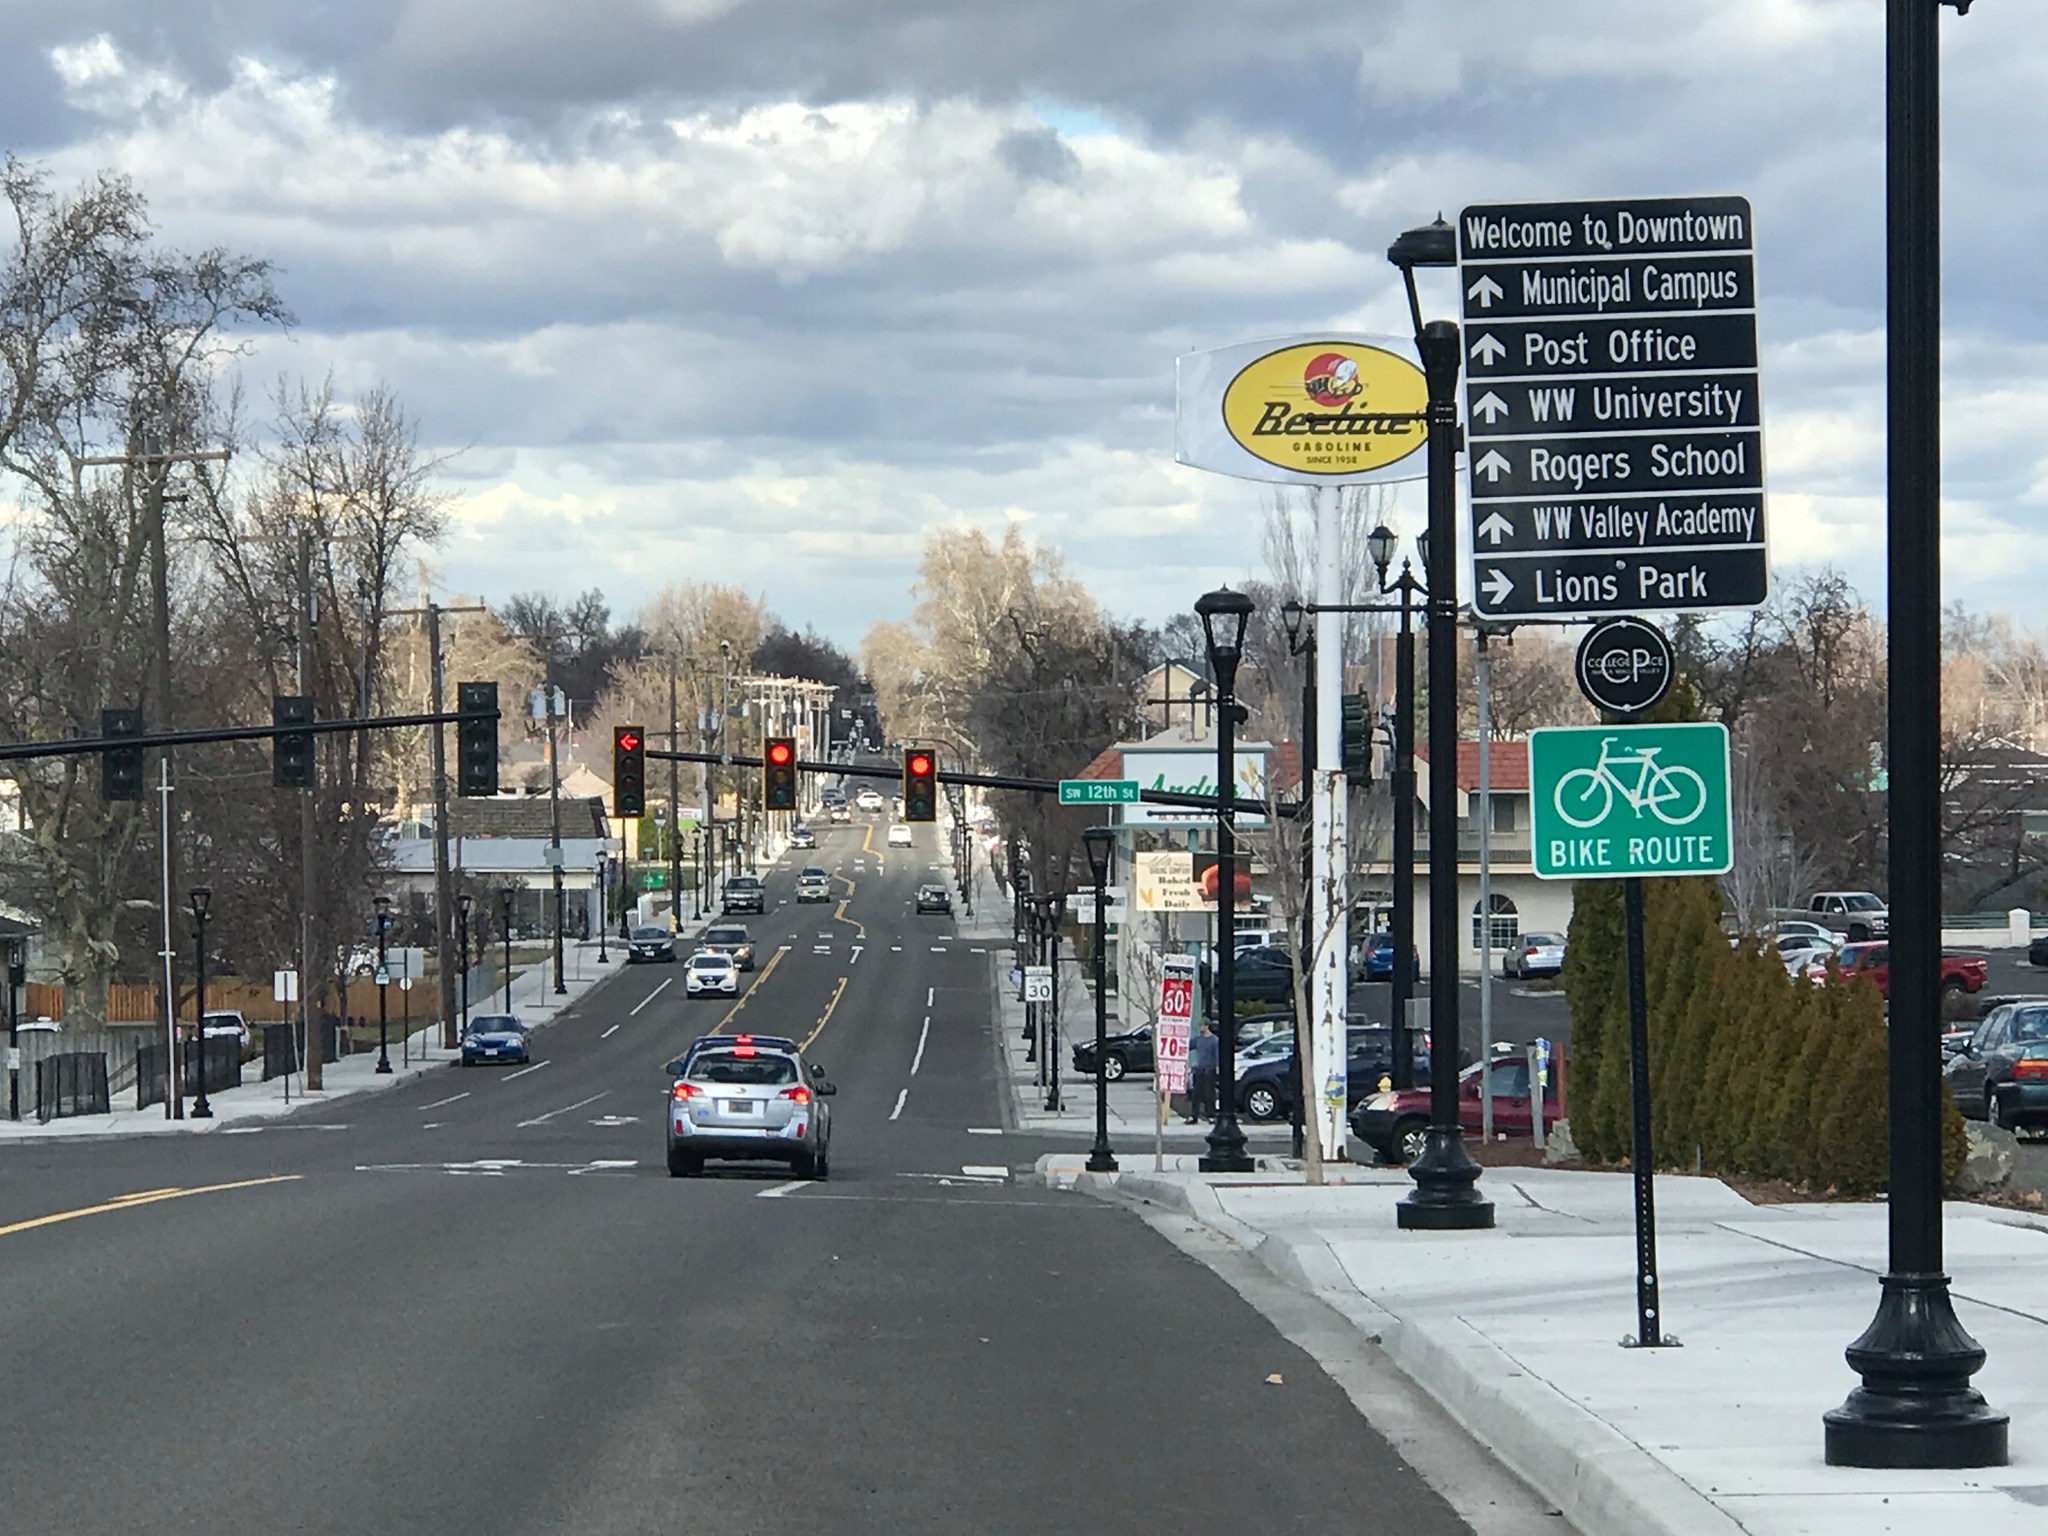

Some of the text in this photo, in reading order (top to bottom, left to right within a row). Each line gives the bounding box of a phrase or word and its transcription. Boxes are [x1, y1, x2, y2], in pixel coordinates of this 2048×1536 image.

[1467, 210, 1744, 249] Welcome to Downtown
[1522, 265, 1738, 311] Municipal Campus
[1525, 329, 1697, 366] Post Office
[1528, 382, 1742, 424] WW University
[1292, 442, 1372, 452] GASOLINE
[1306, 455, 1333, 464] SINCE
[1530, 441, 1745, 491] Rogers School
[1532, 501, 1756, 546] WW Valley Academy
[1535, 565, 1708, 603] Lions Park
[1587, 656, 1631, 668] COLEGE
[1065, 785, 1134, 799] SW 12th St
[1551, 836, 1714, 867] BIKE ROUTE
[1028, 985, 1050, 998] 30
[1164, 989, 1185, 1014] 60
[1160, 1037, 1178, 1057] 70
